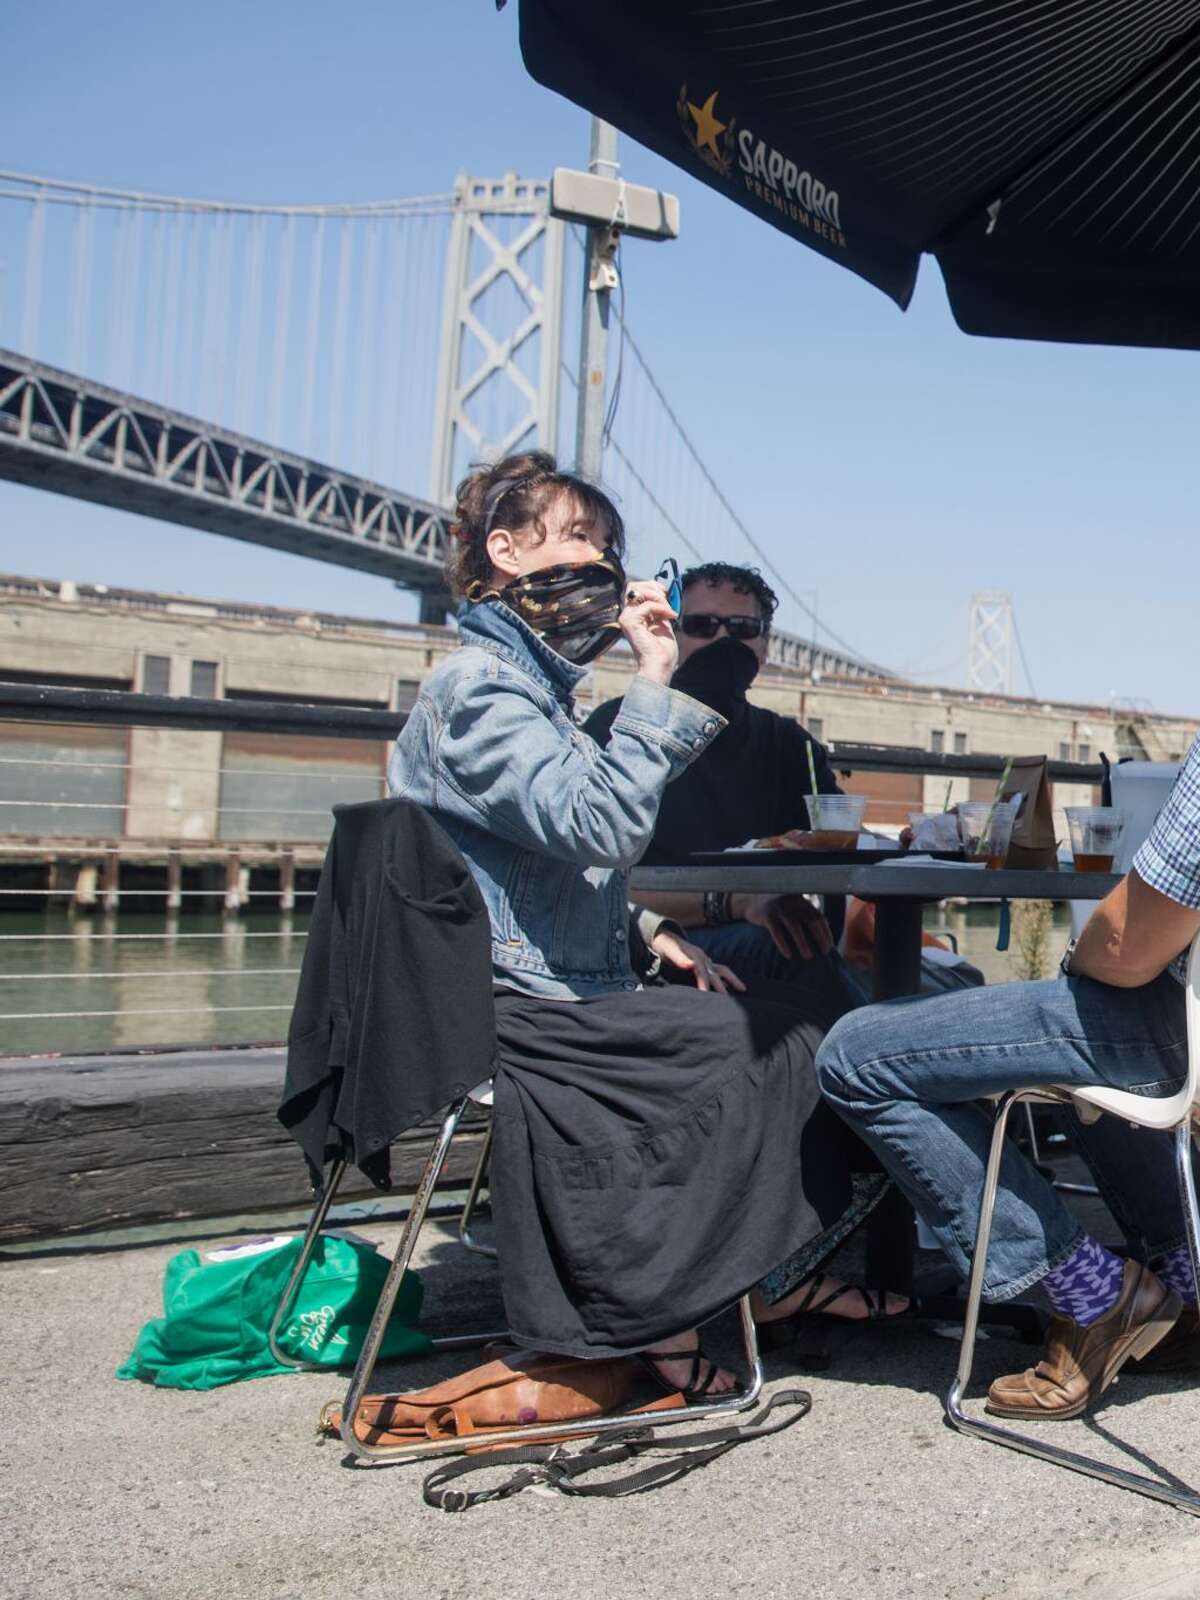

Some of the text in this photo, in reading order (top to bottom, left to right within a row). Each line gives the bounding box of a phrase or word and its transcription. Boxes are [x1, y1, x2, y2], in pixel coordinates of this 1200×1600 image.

[738, 129, 841, 230] SAPPORO
[744, 175, 847, 248] PREMIUM BEER
